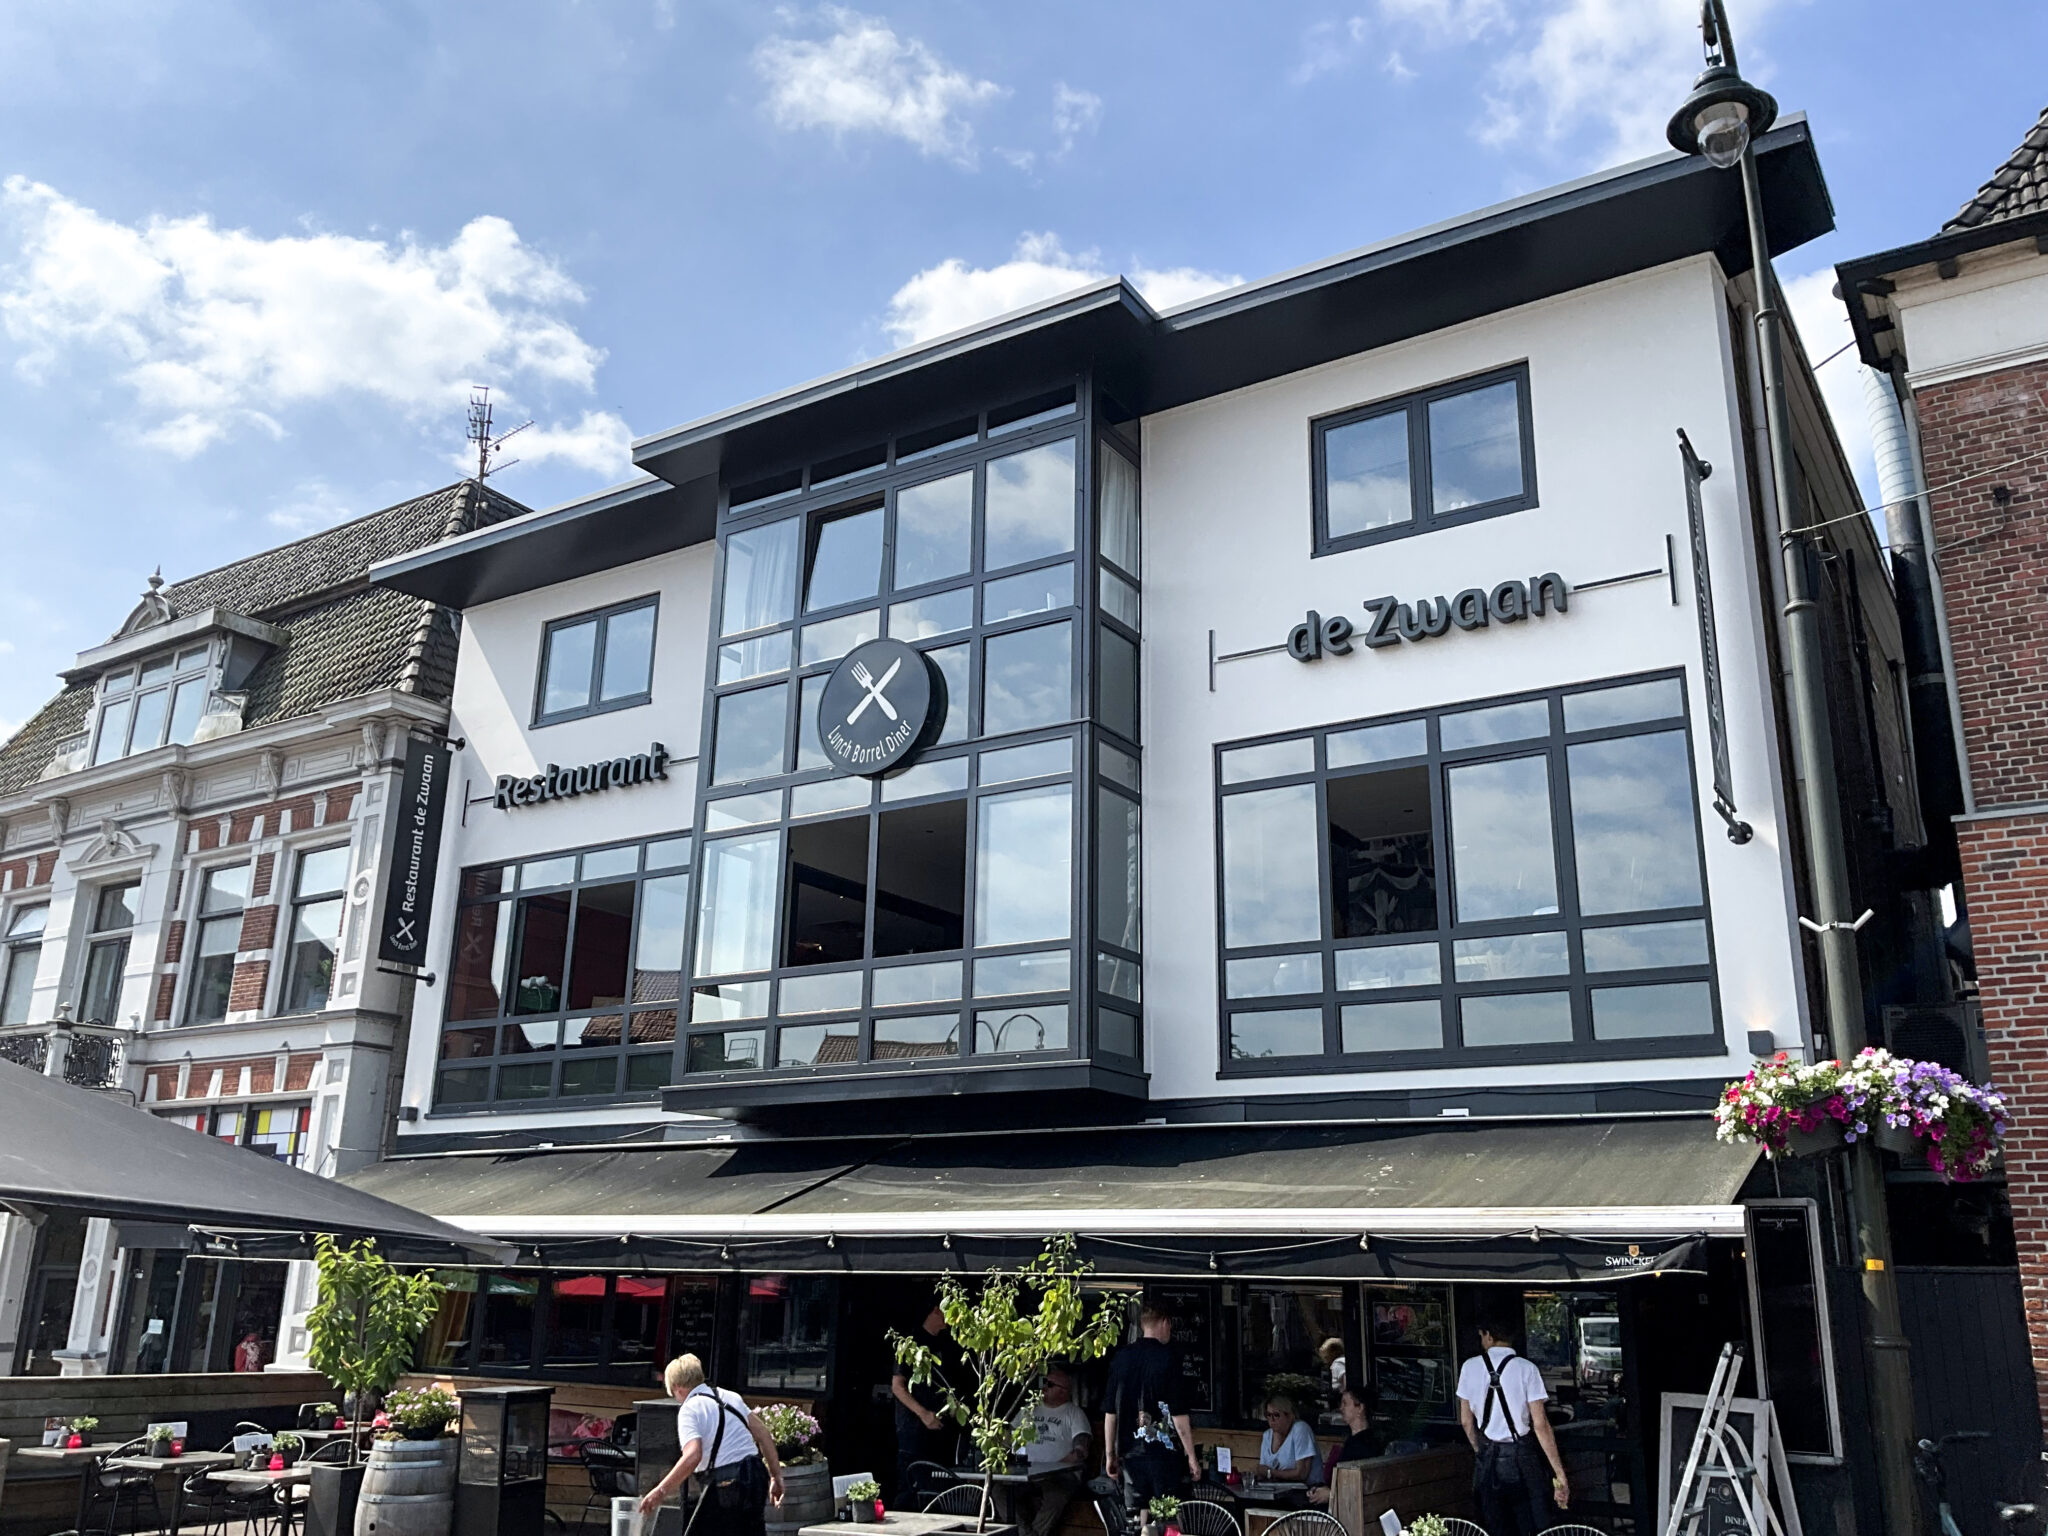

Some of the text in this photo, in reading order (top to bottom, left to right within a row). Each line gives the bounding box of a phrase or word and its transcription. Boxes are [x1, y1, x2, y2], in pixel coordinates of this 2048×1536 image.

[1287, 572, 1568, 662] de Zwaan
[493, 741, 669, 810] Restaurant
[828, 720, 912, 763] Lunch Borrel Diner
[402, 754, 434, 912] Restaurant de Zwaan
